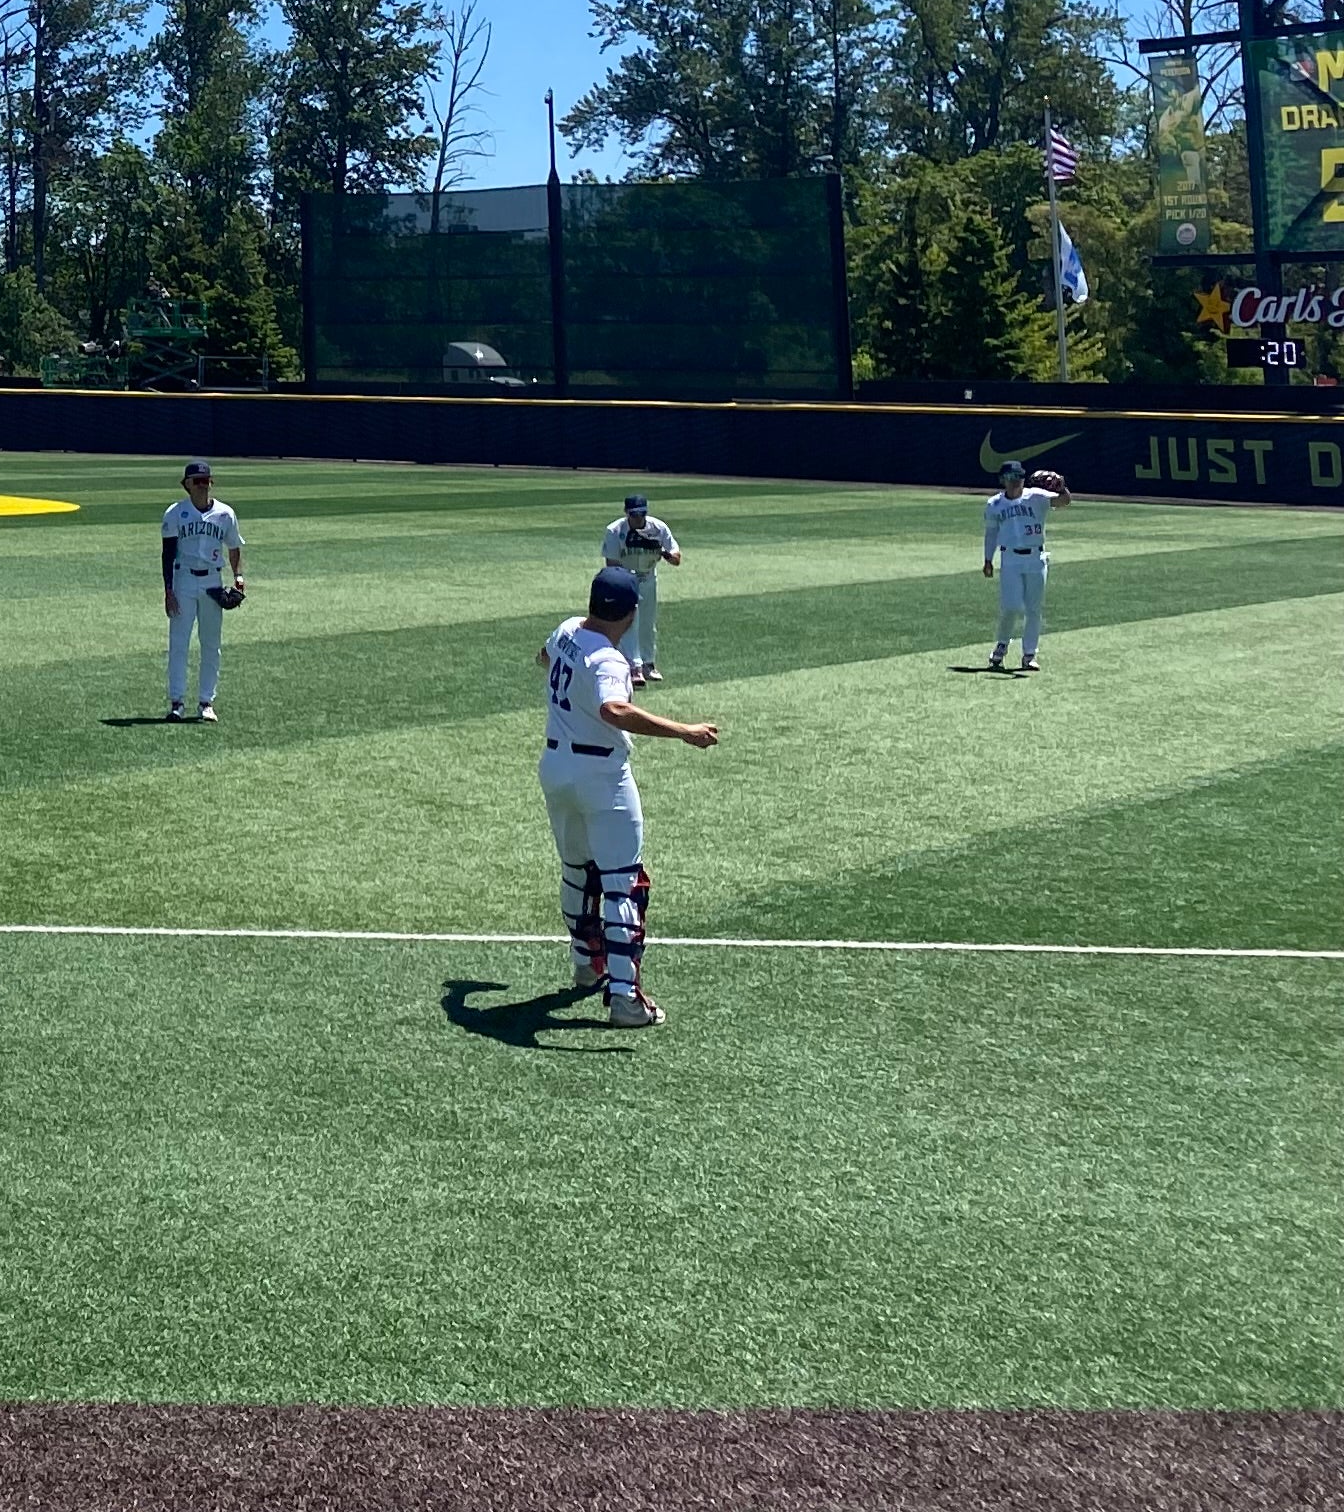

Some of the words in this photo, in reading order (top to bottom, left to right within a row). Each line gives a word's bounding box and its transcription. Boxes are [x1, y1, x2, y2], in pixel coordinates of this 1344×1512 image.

[1281, 104, 1344, 130] DRA
[1166, 209, 1186, 220] PICK
[1232, 284, 1324, 327] Carl's
[1135, 435, 1273, 485] JUST
